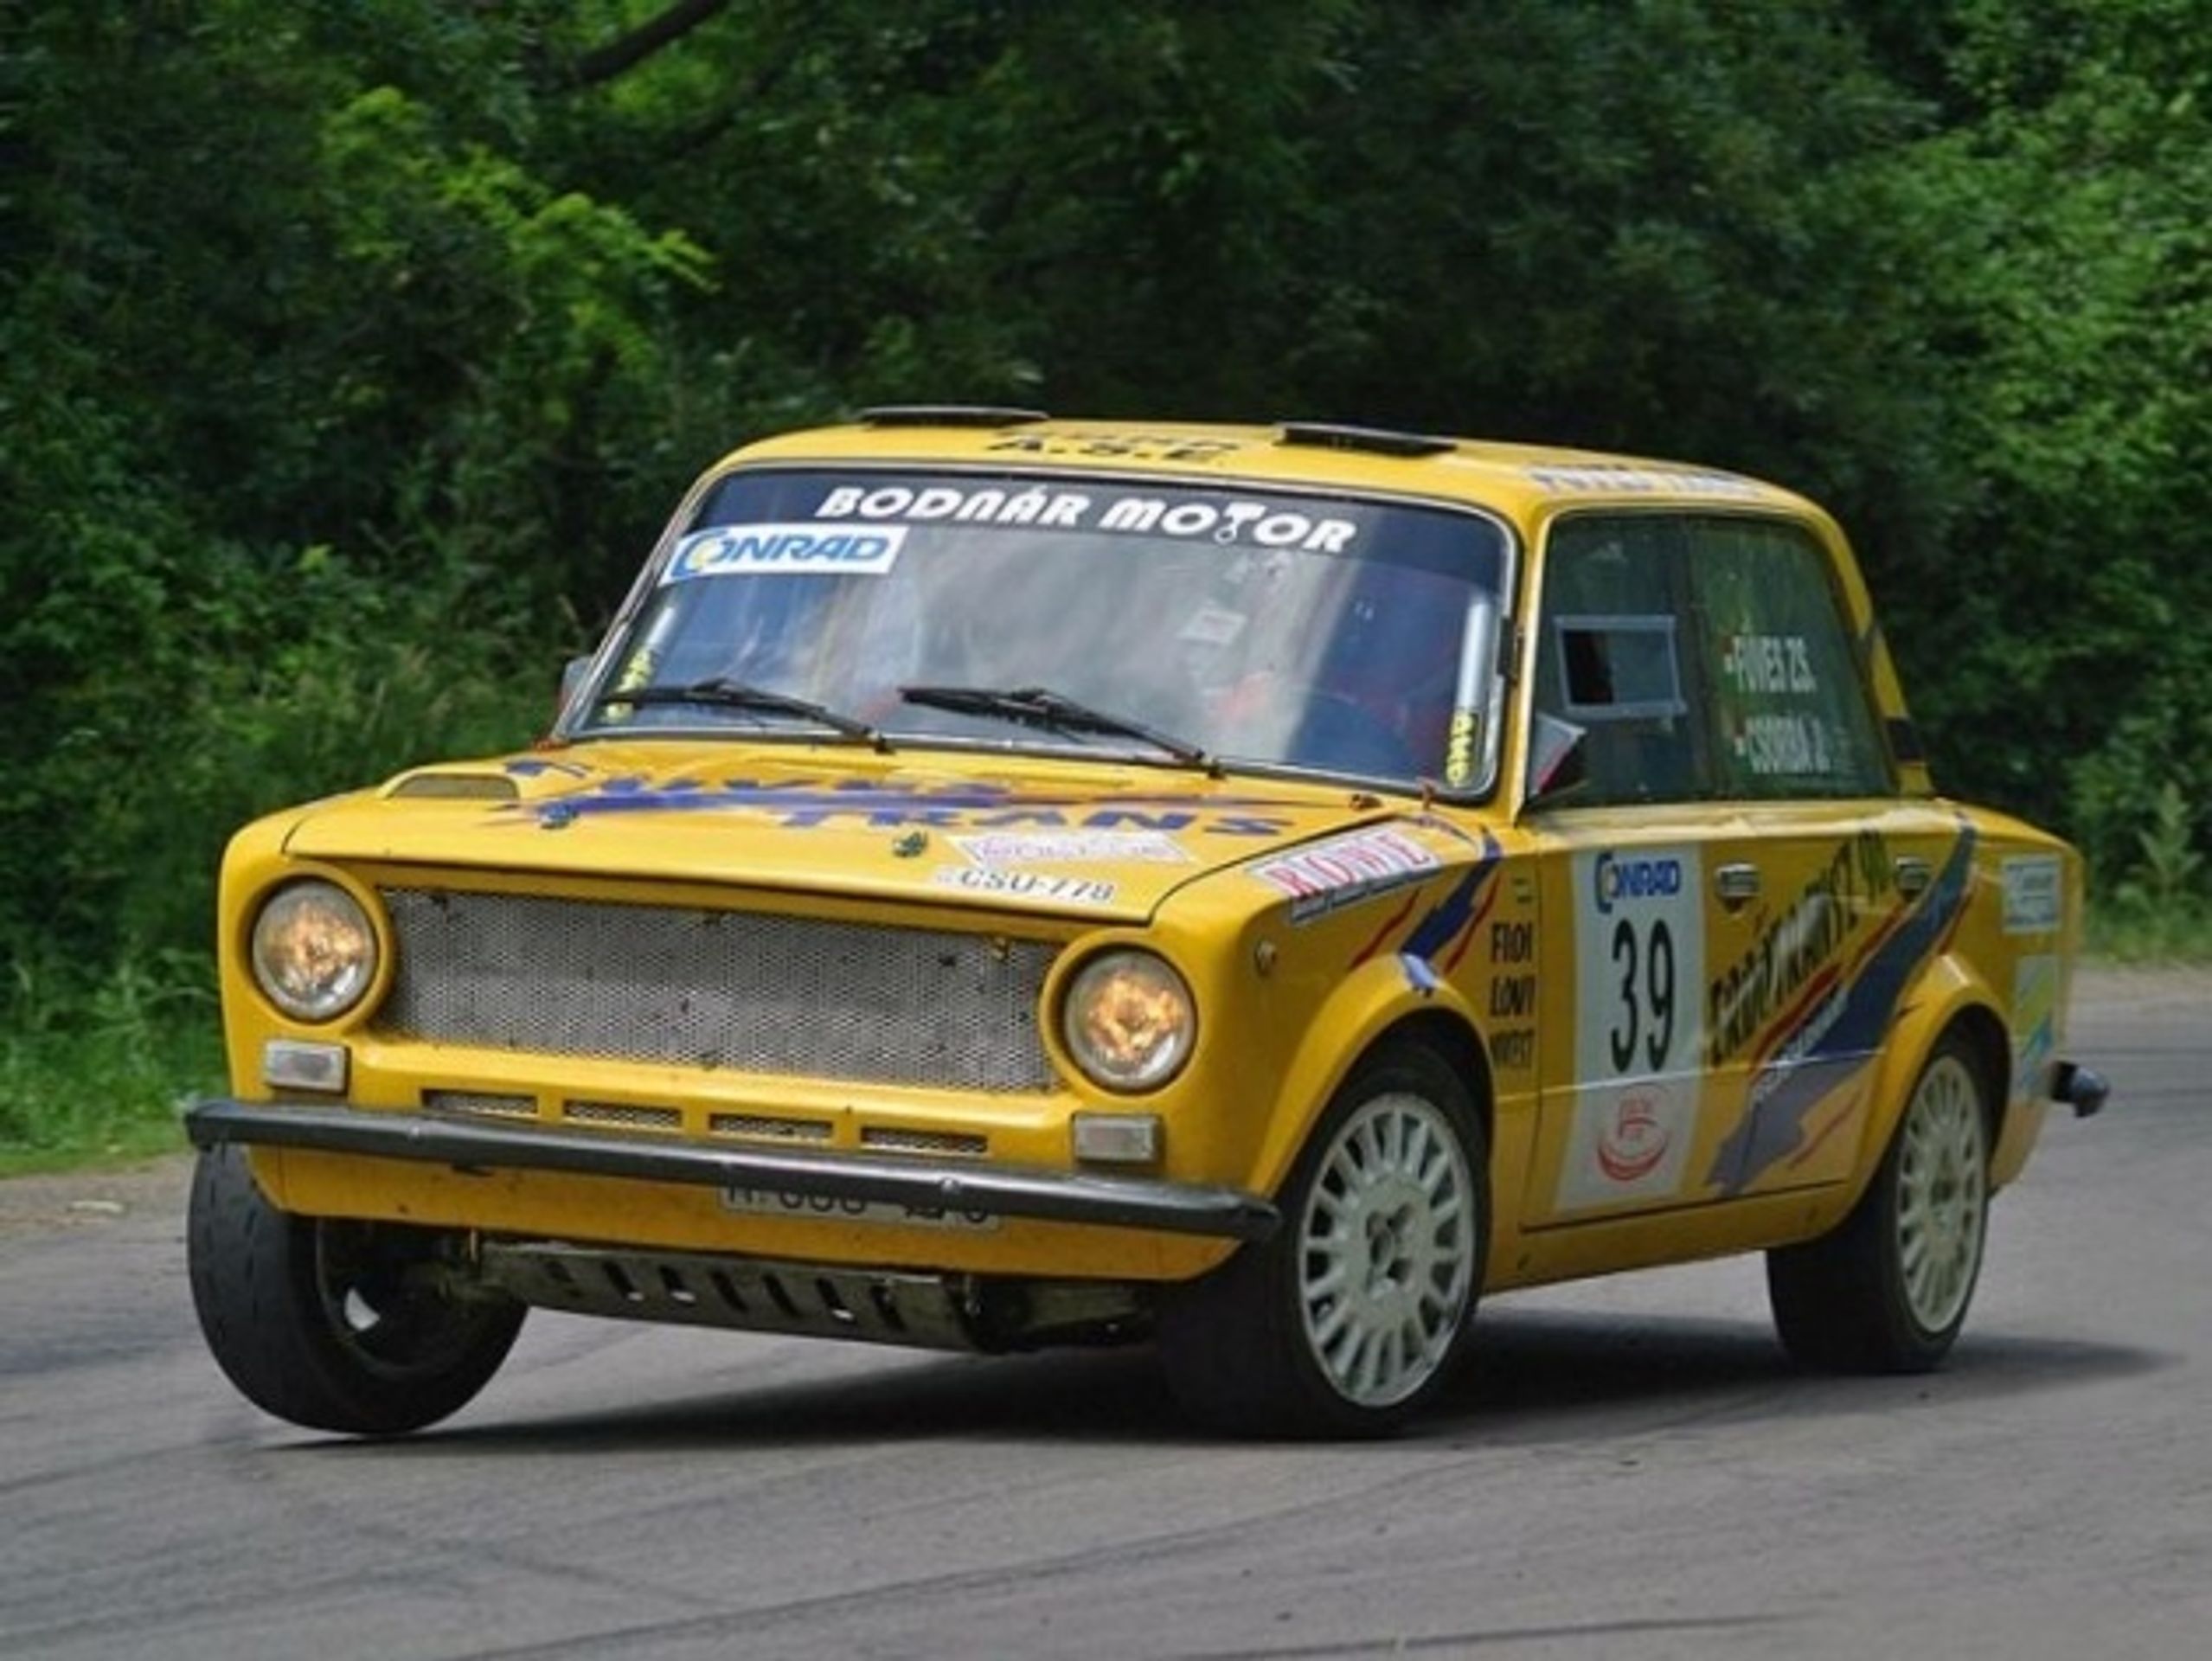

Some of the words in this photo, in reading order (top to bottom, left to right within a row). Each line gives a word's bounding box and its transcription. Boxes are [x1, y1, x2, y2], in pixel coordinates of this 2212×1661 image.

[814, 484, 1091, 526] BODNÁR
[1098, 497, 1357, 554] MOTOR
[1611, 919, 1676, 1073] 39
